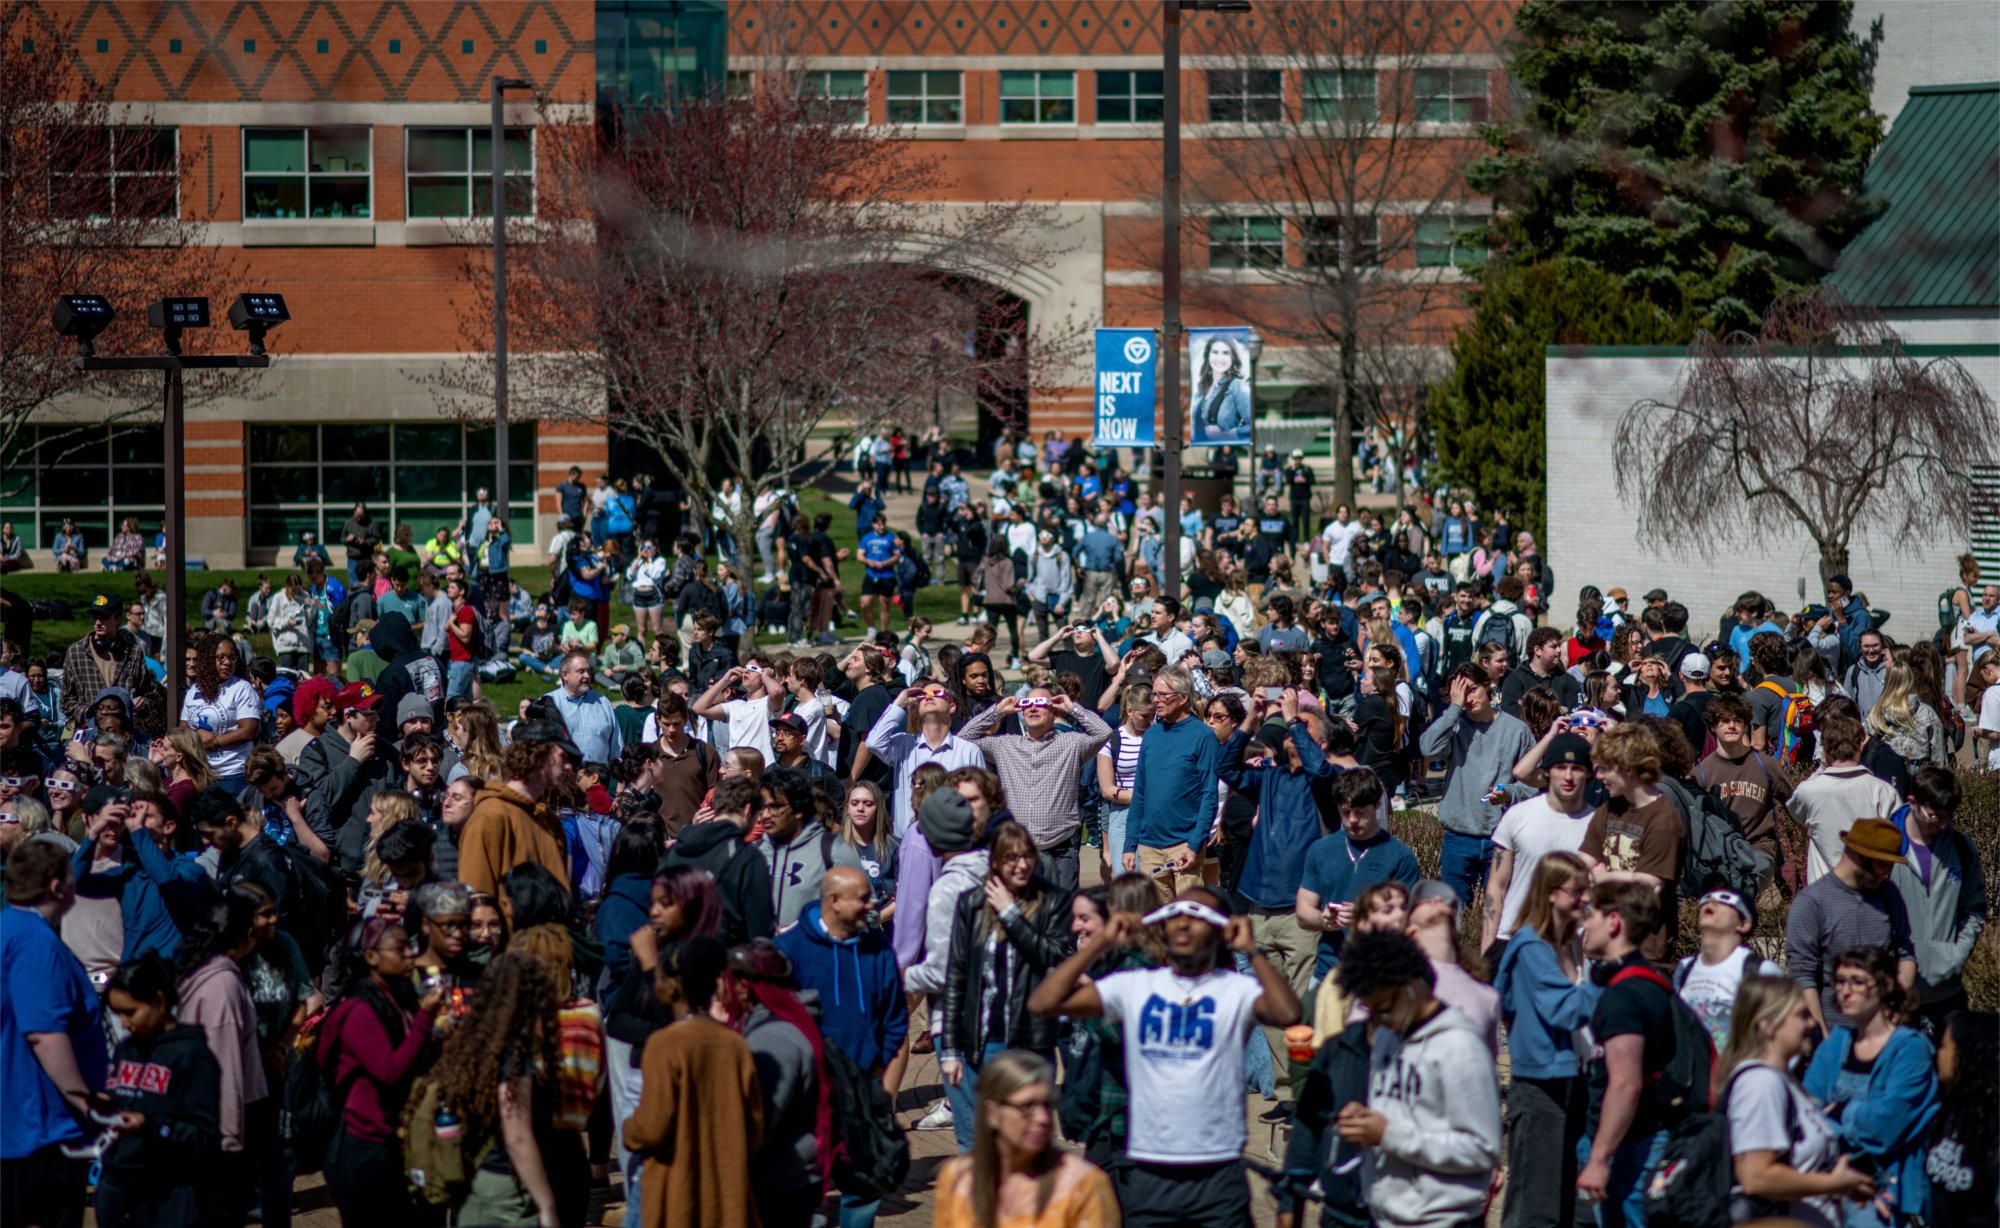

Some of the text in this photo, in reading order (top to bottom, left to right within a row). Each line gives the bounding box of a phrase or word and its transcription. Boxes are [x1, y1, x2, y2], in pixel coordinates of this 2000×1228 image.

[1100, 372, 1142, 393] NEXT
[1099, 395, 1116, 416] IS
[1099, 418, 1137, 440] NOW
[1720, 782, 1728, 800] IC
[1138, 992, 1216, 1051] 616
